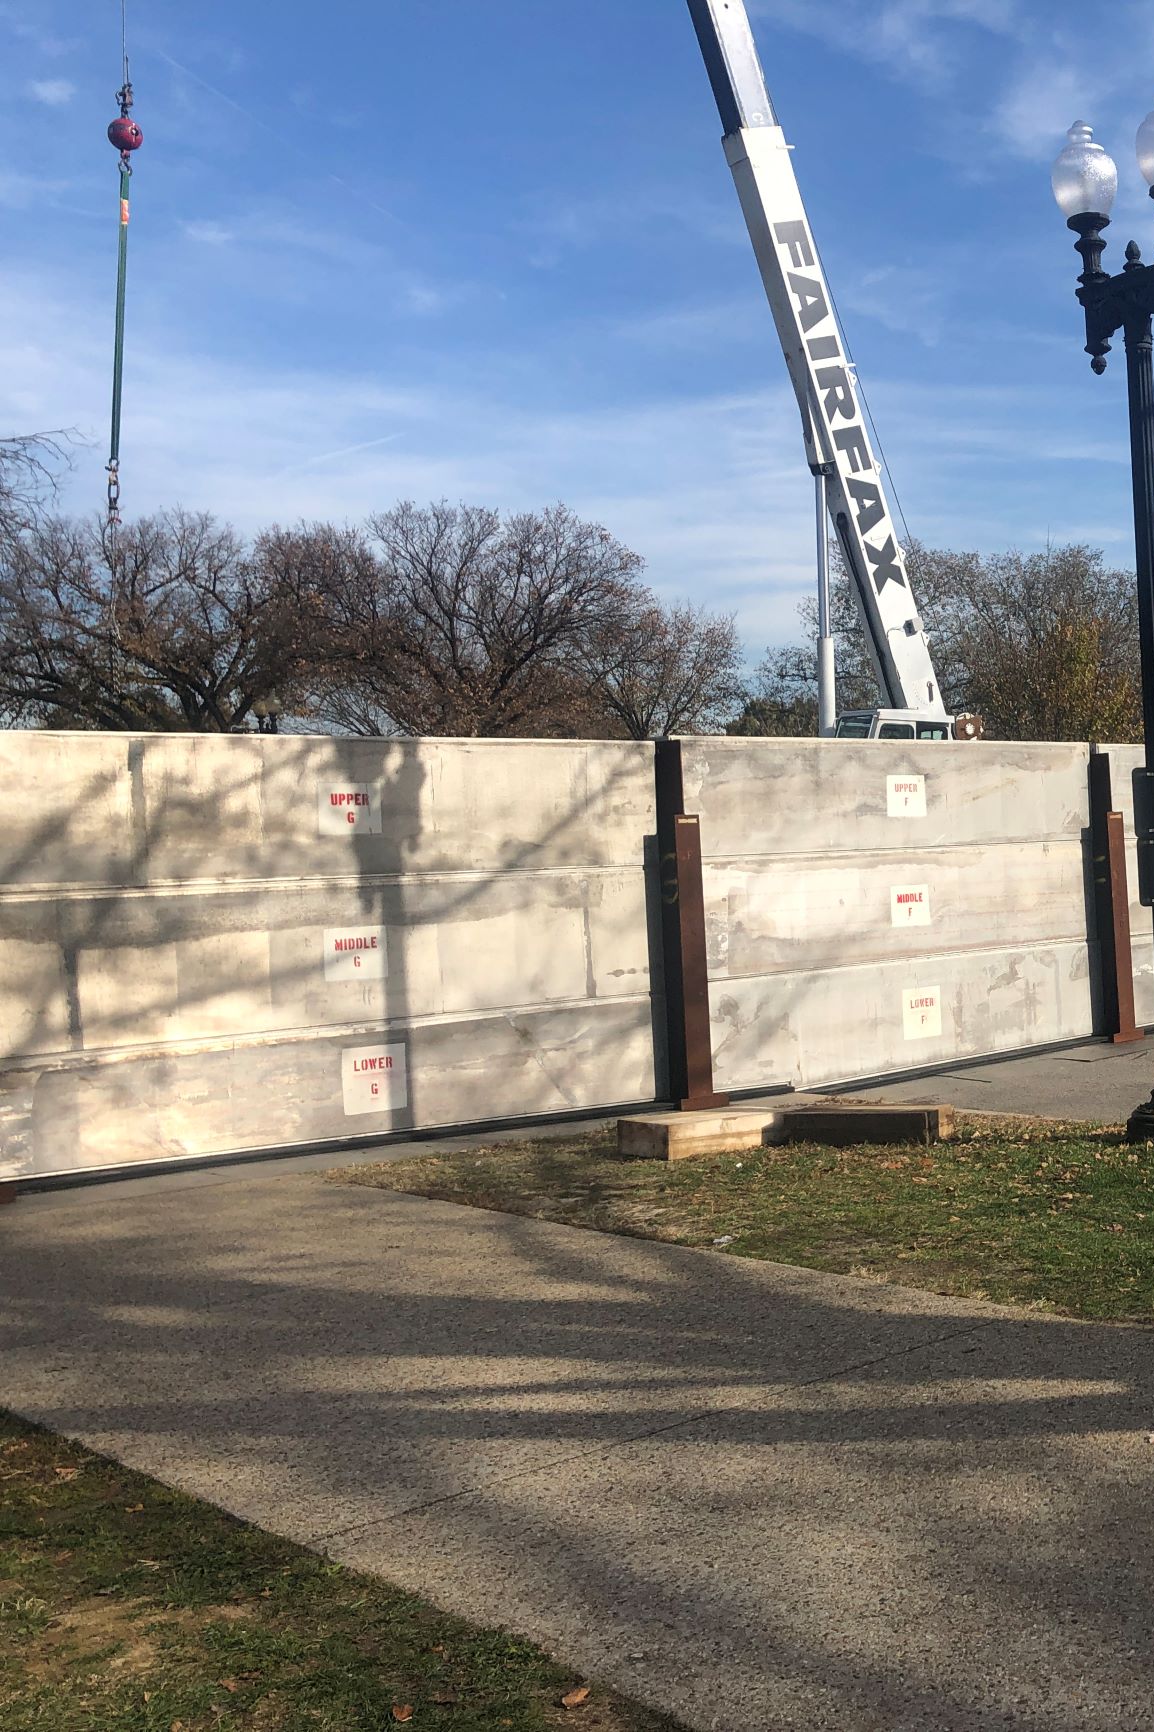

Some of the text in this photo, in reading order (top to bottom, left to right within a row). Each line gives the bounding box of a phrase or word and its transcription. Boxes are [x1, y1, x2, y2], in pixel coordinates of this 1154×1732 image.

[773, 220, 906, 596] FAIRFAX
[894, 783, 918, 793] UPPER
[330, 793, 369, 806] UPPER
[347, 811, 355, 824] G
[896, 892, 923, 904] MIDDLE
[334, 936, 378, 951] MIDDLE
[353, 955, 361, 967] G
[910, 997, 934, 1009] LOWER
[353, 1056, 393, 1072] LOWER
[370, 1082, 379, 1095] G
